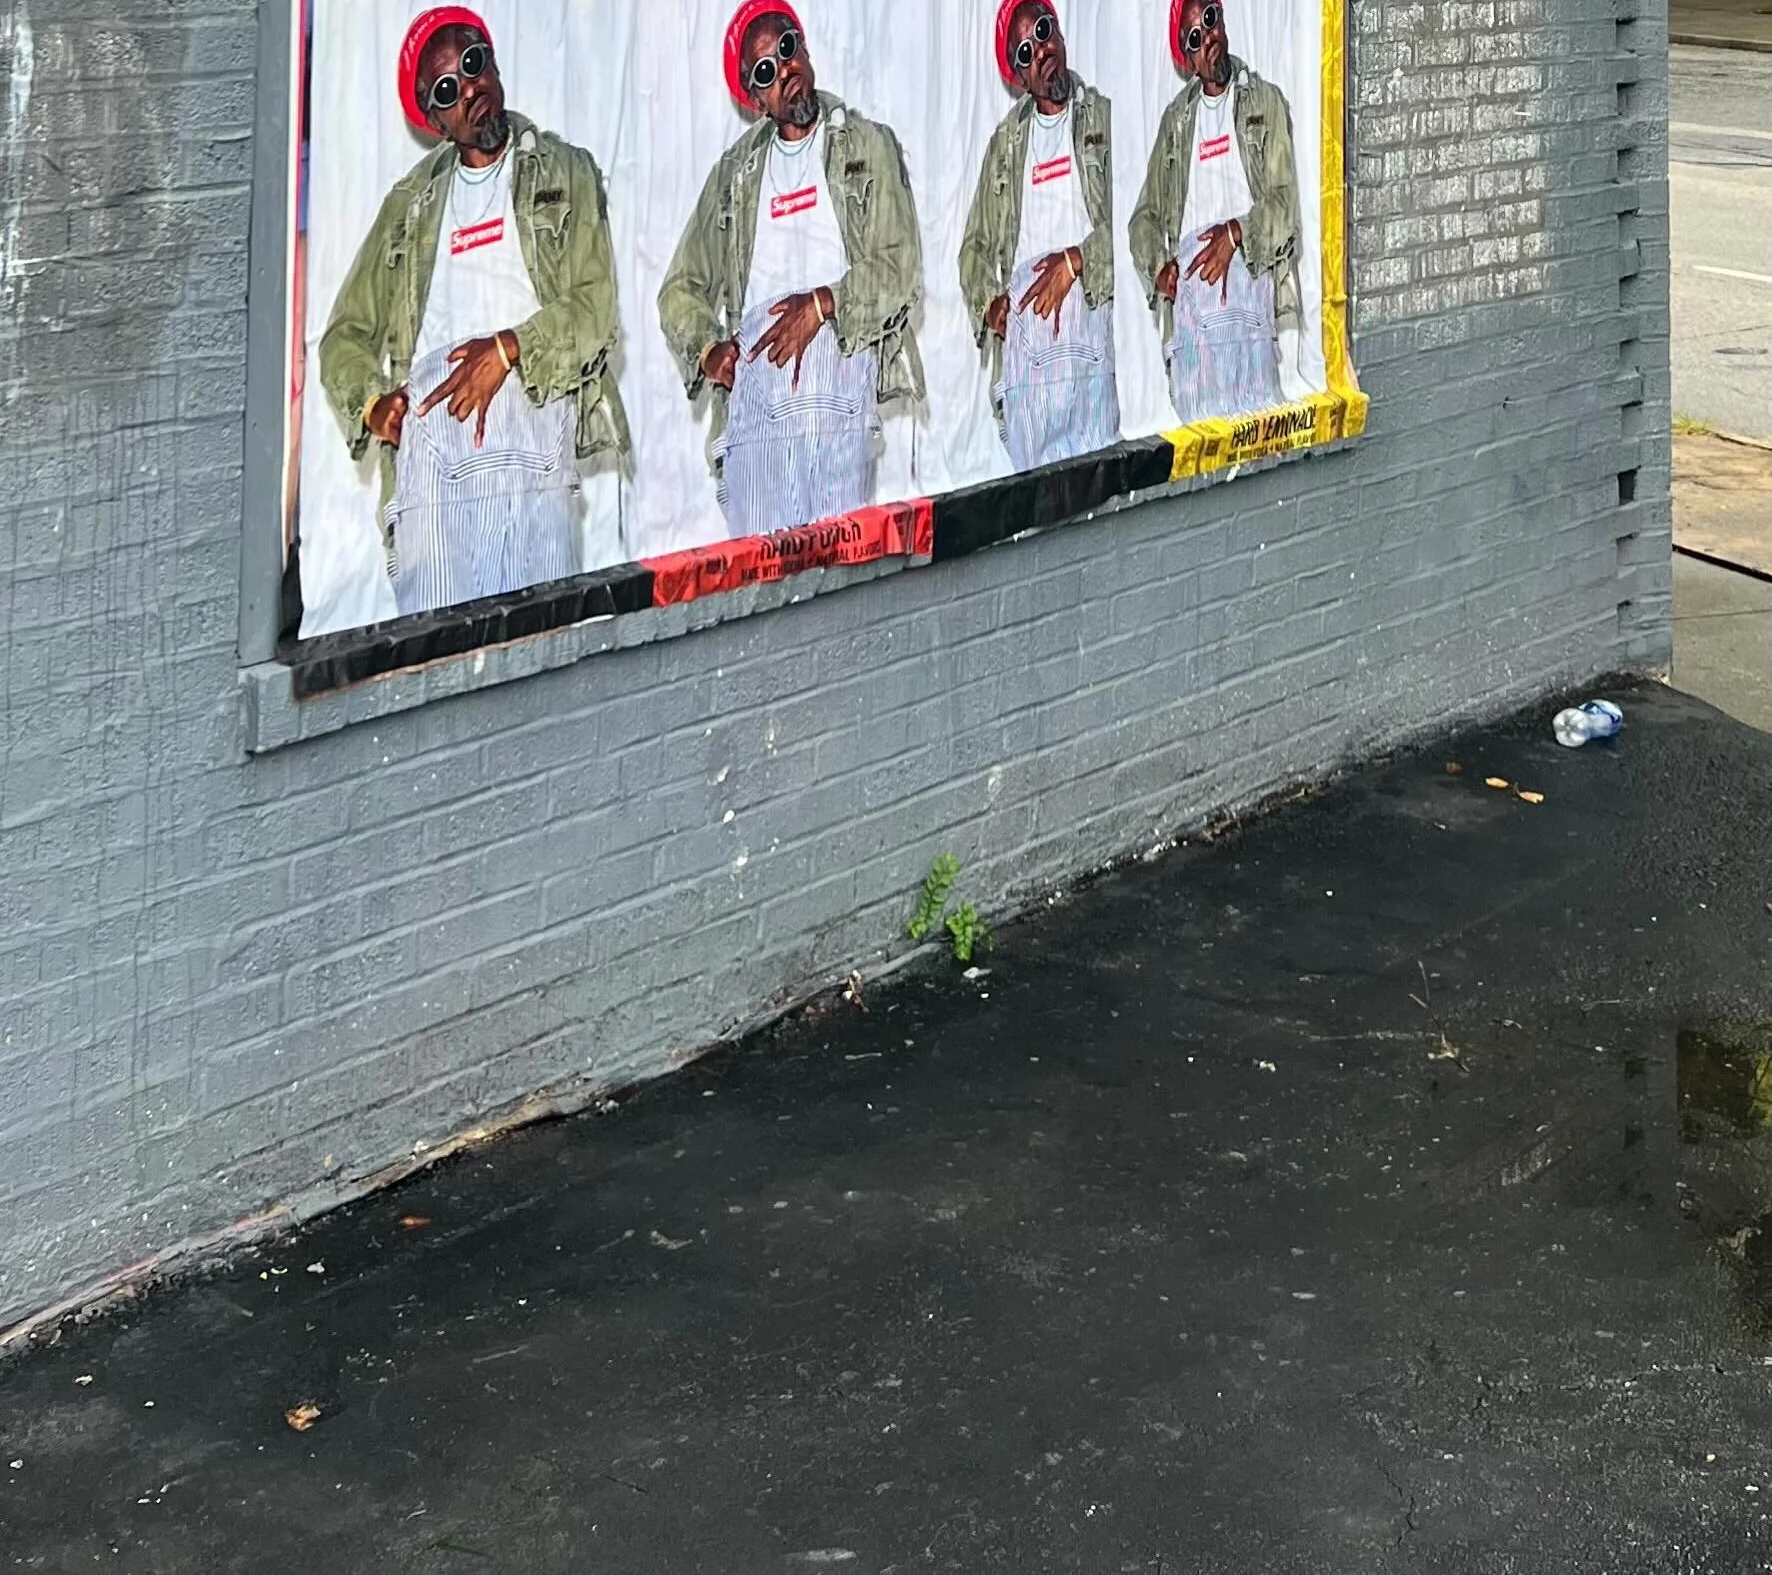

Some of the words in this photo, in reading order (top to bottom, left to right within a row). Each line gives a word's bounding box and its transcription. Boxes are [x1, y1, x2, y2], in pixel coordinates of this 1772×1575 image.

[1034, 161, 1071, 181] Supreme
[773, 192, 816, 214] Supreme
[452, 224, 503, 249] Supreme
[1231, 420, 1260, 448] HARD
